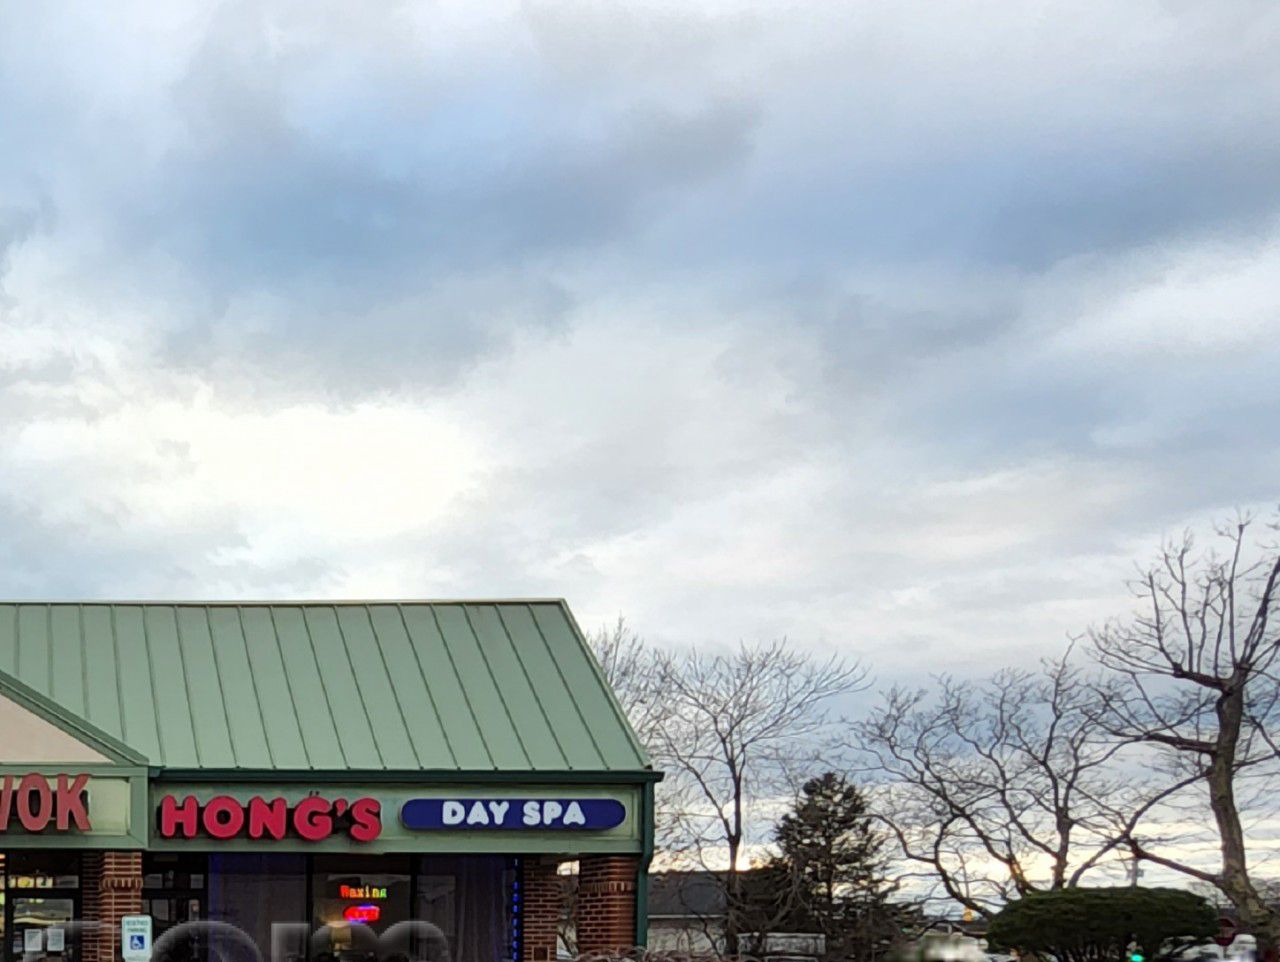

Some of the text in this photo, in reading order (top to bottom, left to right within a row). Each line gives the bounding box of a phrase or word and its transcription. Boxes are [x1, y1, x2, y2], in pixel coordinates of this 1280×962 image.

[161, 795, 382, 842] HONG'S
[442, 801, 586, 826] DAY SPA
